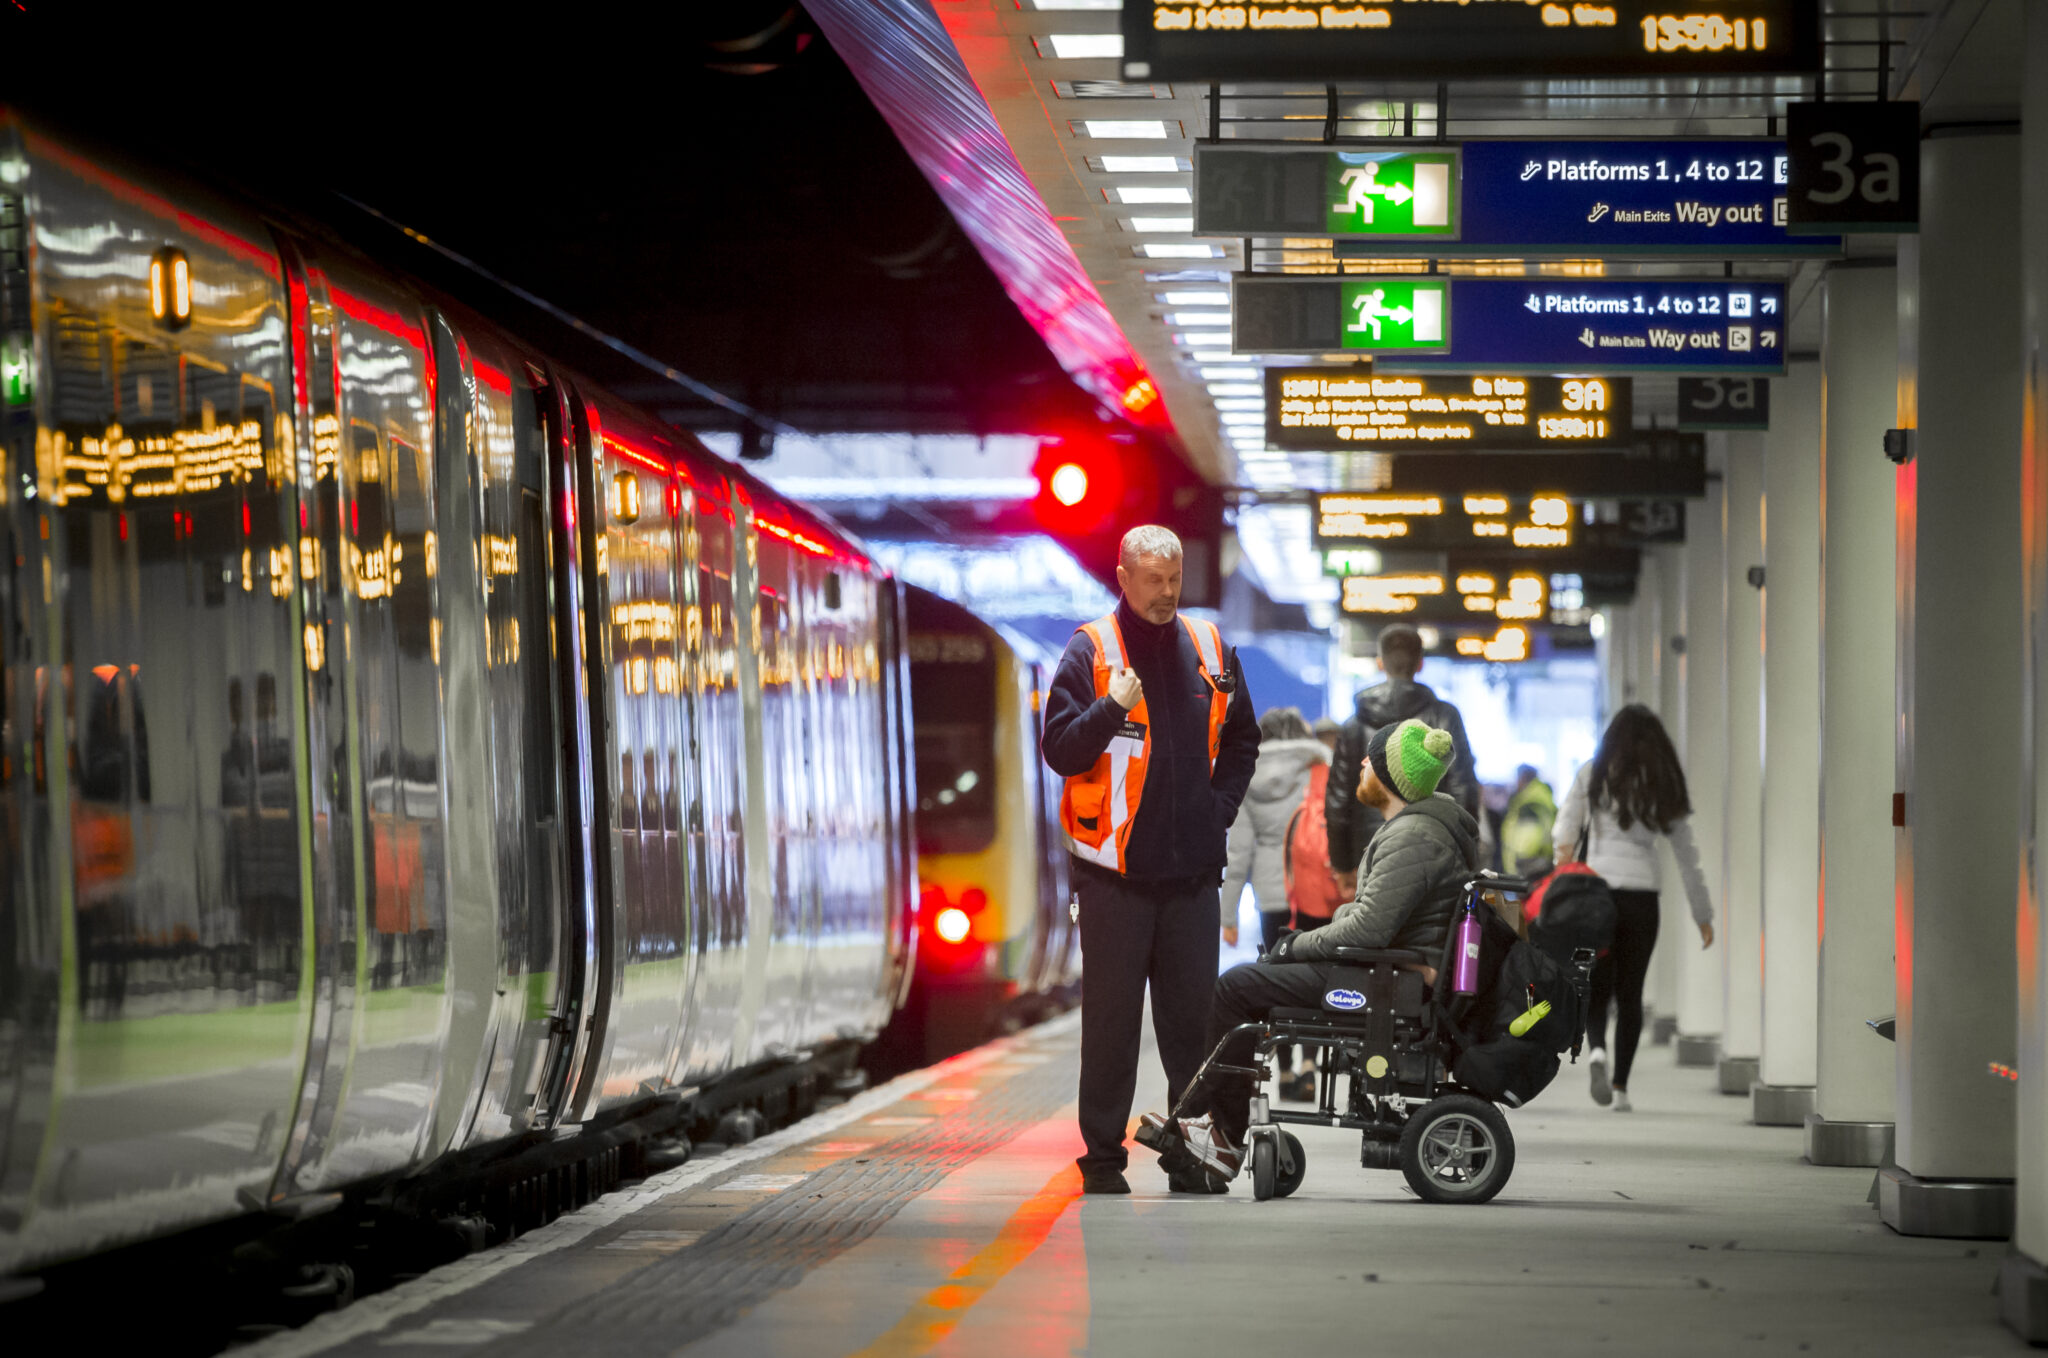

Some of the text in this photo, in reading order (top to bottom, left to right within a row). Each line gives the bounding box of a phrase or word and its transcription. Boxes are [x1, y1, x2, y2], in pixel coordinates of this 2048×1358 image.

[1547, 160, 1650, 180] Platforms
[1685, 160, 1701, 180] 4
[1706, 162, 1730, 181] to
[1736, 160, 1764, 180] 12
[1807, 131, 1900, 204] 3a
[1614, 202, 1763, 227] Main Exits Way out
[1545, 295, 1629, 313] Platforms
[1657, 296, 1671, 313] 4
[1674, 298, 1693, 314] to
[1698, 296, 1720, 314] 12
[1600, 328, 1720, 351] Main Exits Way out
[1562, 381, 1605, 411] 3A
